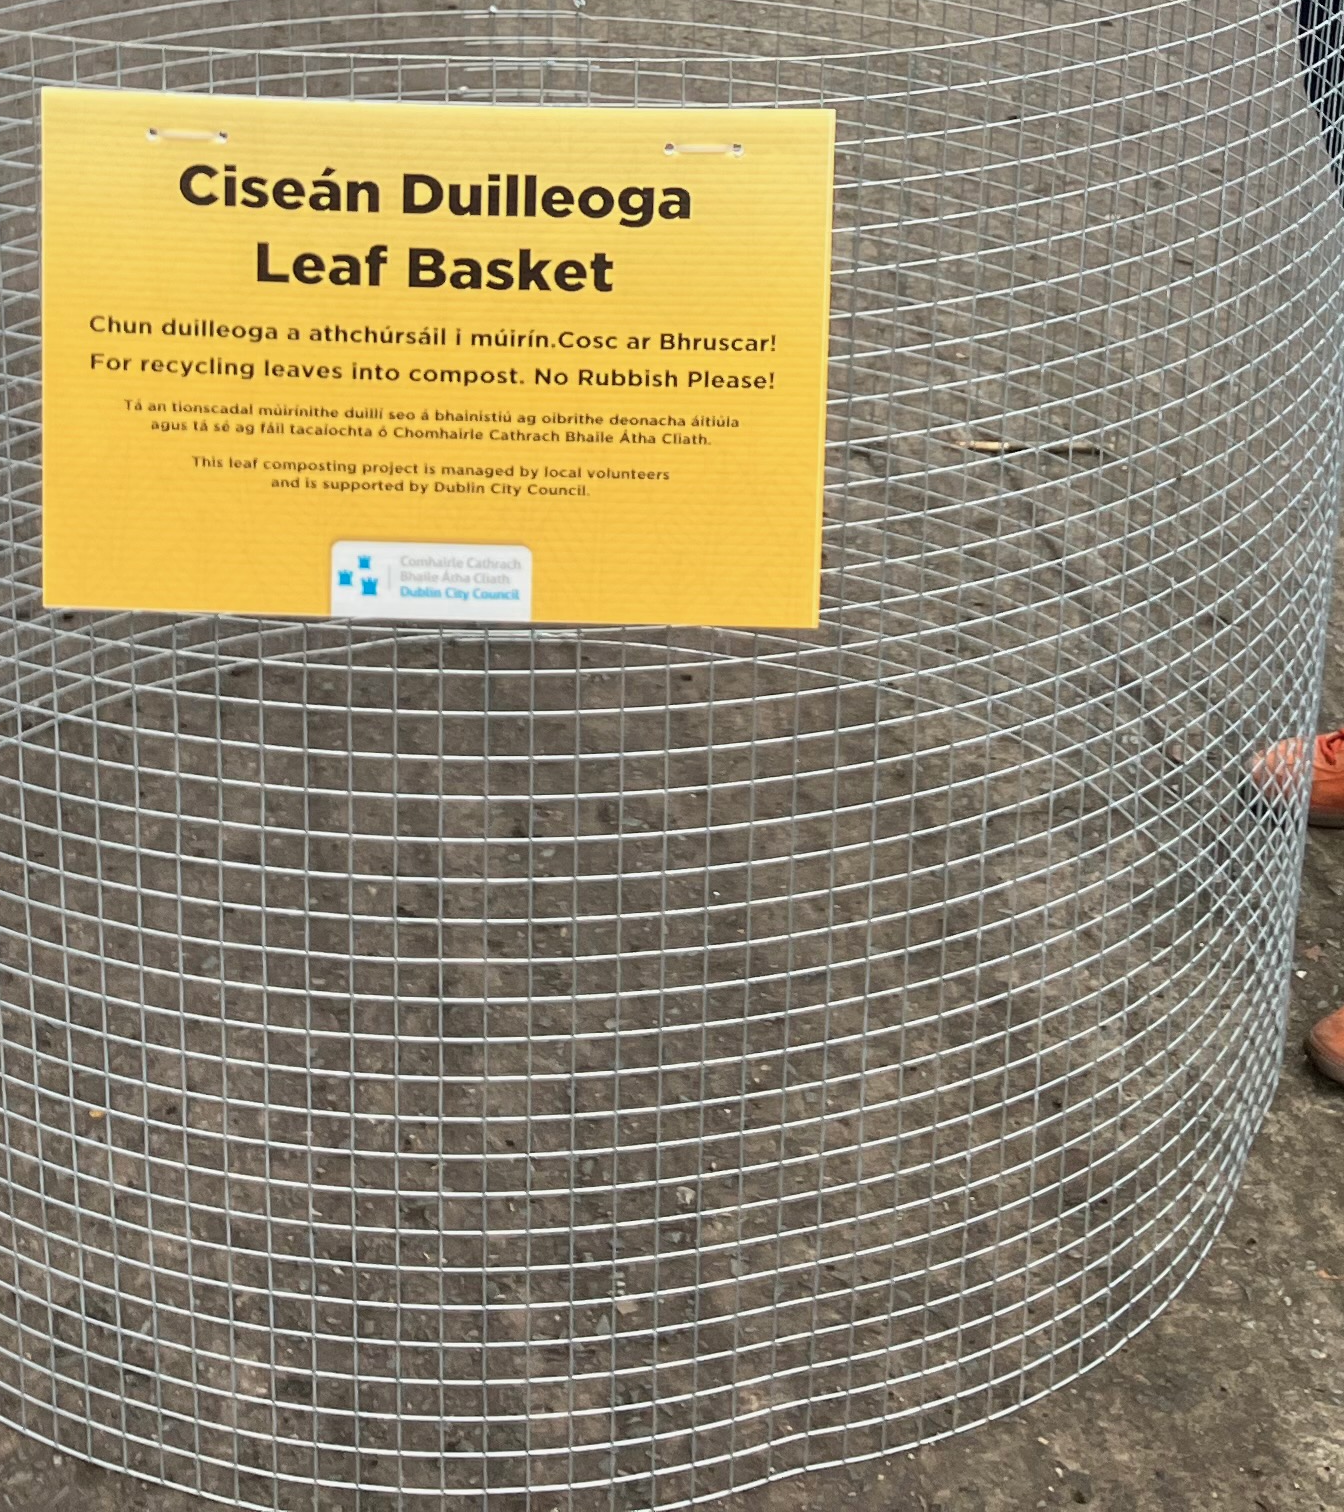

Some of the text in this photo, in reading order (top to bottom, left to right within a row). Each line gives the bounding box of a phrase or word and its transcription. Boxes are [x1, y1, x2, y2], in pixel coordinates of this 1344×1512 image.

[179, 163, 691, 228] Ciseán Duilleoga
[256, 241, 614, 293] Leaf Basket
[89, 315, 152, 335] Chun
[161, 318, 278, 344] duilleoga
[287, 328, 300, 341] a
[309, 324, 446, 346] athchúrsáil
[456, 328, 461, 346] i
[626, 336, 651, 350] ar
[660, 332, 776, 352] Bhruscar!
[91, 353, 774, 389] For recycling leaves into compost. No Rubbish Please!
[192, 456, 670, 480] This leaf composting project is managed by local volunteers
[271, 477, 590, 497] and is supported by Dublin City Council.
[400, 555, 521, 569] Comhairle Cathrach
[400, 585, 520, 600] Dublin City Council
